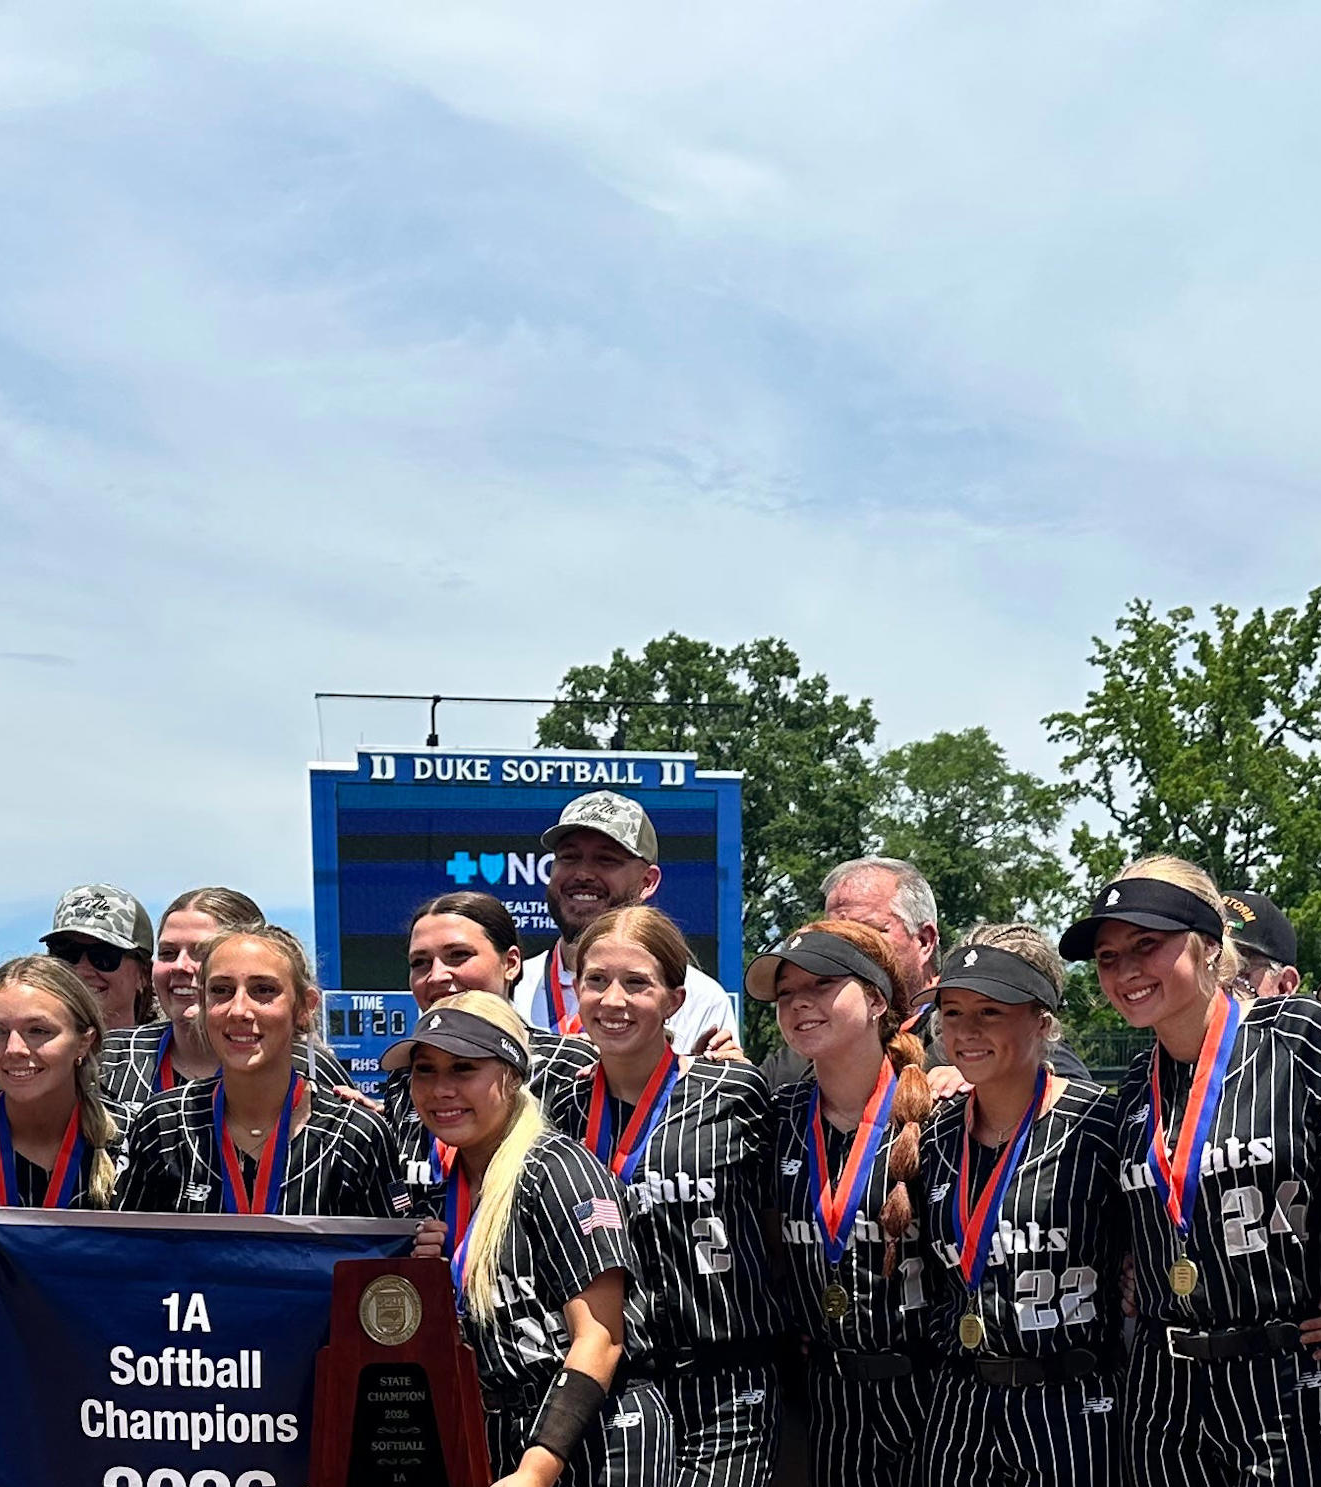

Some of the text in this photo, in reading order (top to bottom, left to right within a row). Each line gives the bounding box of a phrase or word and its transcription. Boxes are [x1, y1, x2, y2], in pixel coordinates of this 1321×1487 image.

[414, 757, 490, 782] DUKE
[502, 760, 643, 784] SOFTBALL
[507, 852, 556, 885] NC
[502, 901, 549, 913] EALTH
[1222, 896, 1257, 922] STORM
[351, 996, 384, 1010] TIME
[358, 1010, 406, 1035] 1:20
[351, 1058, 379, 1071] RHS
[692, 1217, 731, 1274] 2
[898, 1257, 928, 1311] 1
[1015, 1266, 1098, 1331] 22
[162, 1293, 211, 1332] 1A
[109, 1346, 262, 1389] Softball
[379, 1376, 413, 1386] STATE
[367, 1391, 426, 1402] CHAMPION
[81, 1399, 298, 1451] Champions
[385, 1409, 410, 1419] 2026
[371, 1441, 426, 1451] SOFTBALL
[393, 1473, 407, 1483] 1A
